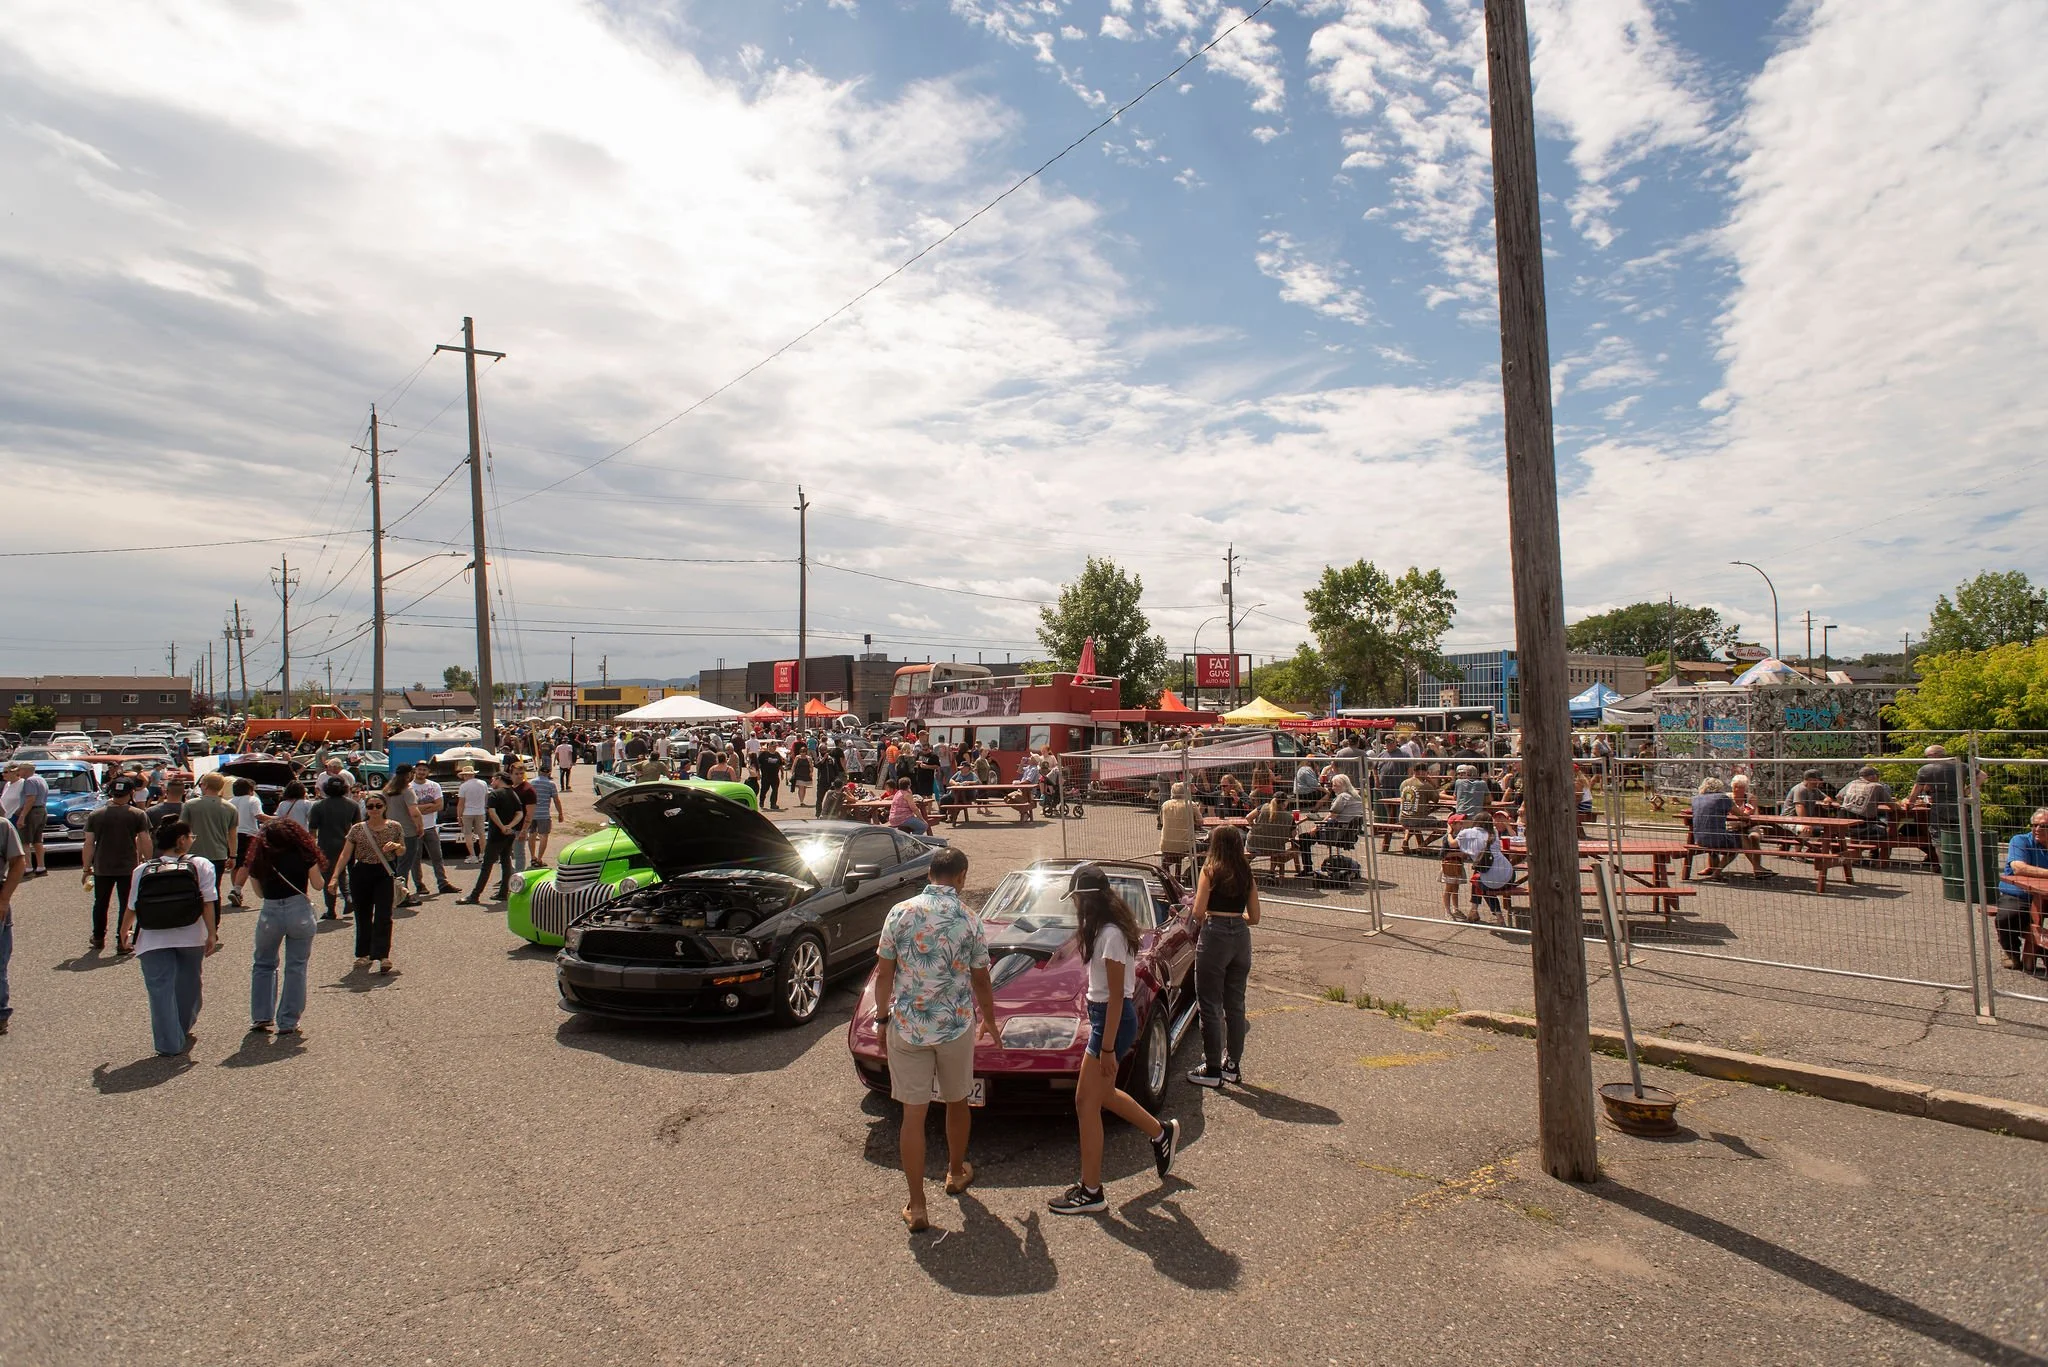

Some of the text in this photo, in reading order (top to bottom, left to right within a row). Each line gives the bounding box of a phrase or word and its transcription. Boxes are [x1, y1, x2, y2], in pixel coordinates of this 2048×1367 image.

[1209, 658, 1229, 669] FAT
[1209, 670, 1230, 678] GUYS
[942, 696, 980, 711] UNION JACK'D
[1784, 707, 1832, 730] EPIC
